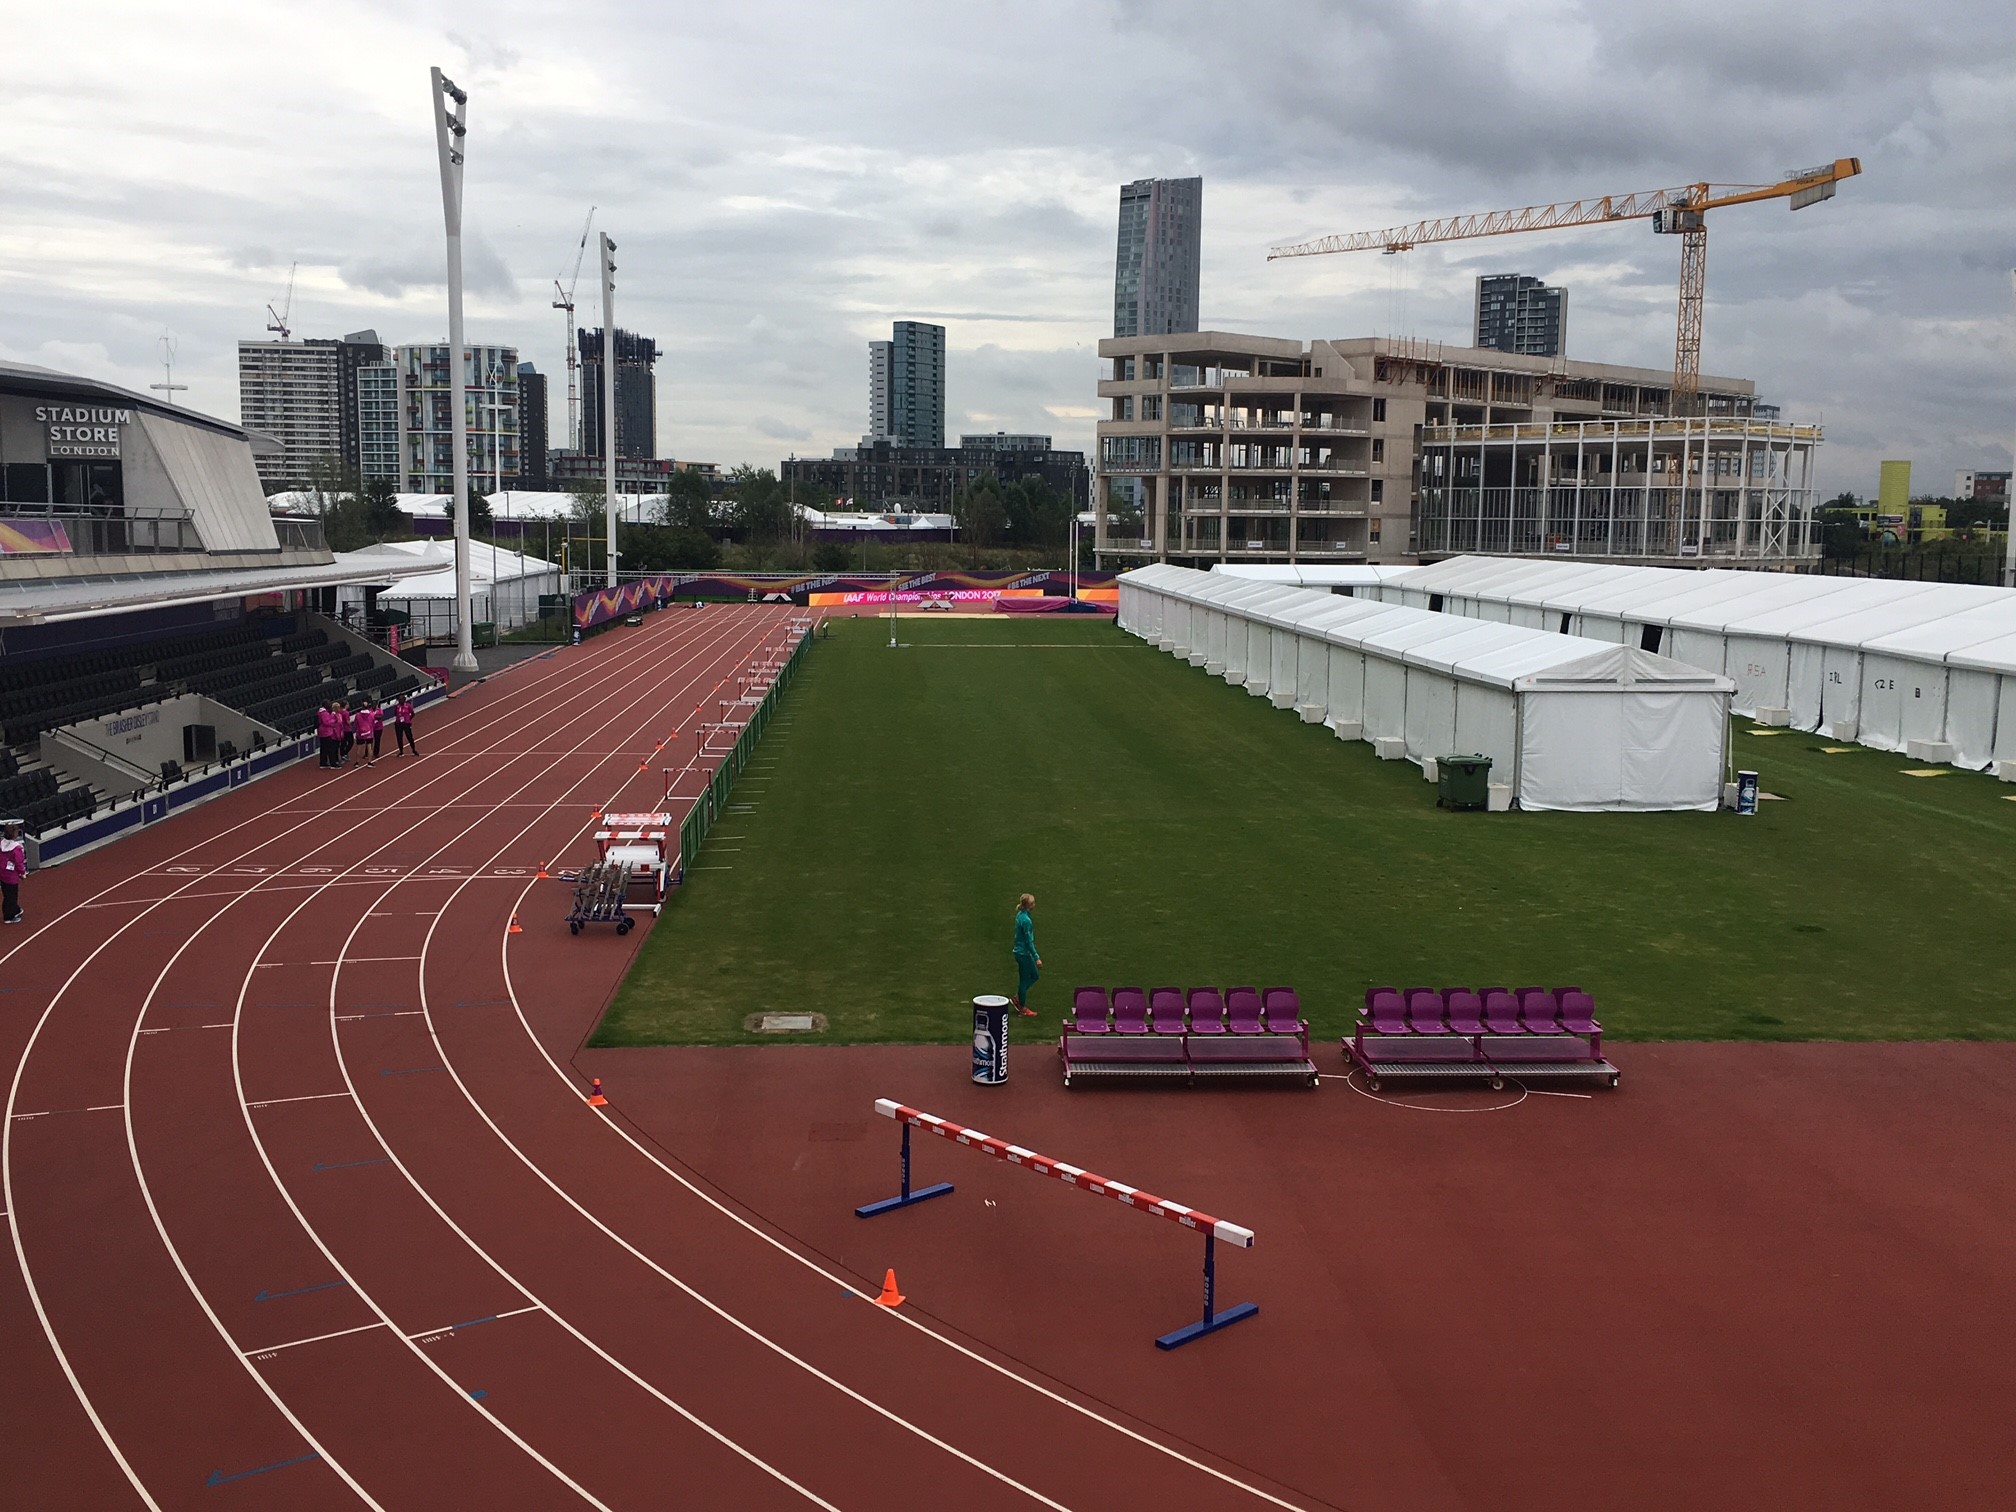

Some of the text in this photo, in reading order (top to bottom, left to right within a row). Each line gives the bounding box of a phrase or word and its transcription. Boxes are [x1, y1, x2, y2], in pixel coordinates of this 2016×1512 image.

[35, 406, 131, 424] STADIUM
[50, 426, 119, 442] STORE
[50, 445, 119, 456] LONDON
[909, 577, 921, 588] THE
[921, 572, 936, 584] BEST
[1020, 576, 1032, 587] THE
[1032, 572, 1050, 583] NEXT
[843, 593, 865, 602] IAAF
[866, 592, 887, 602] World
[999, 1013, 1008, 1077] Strathmore
